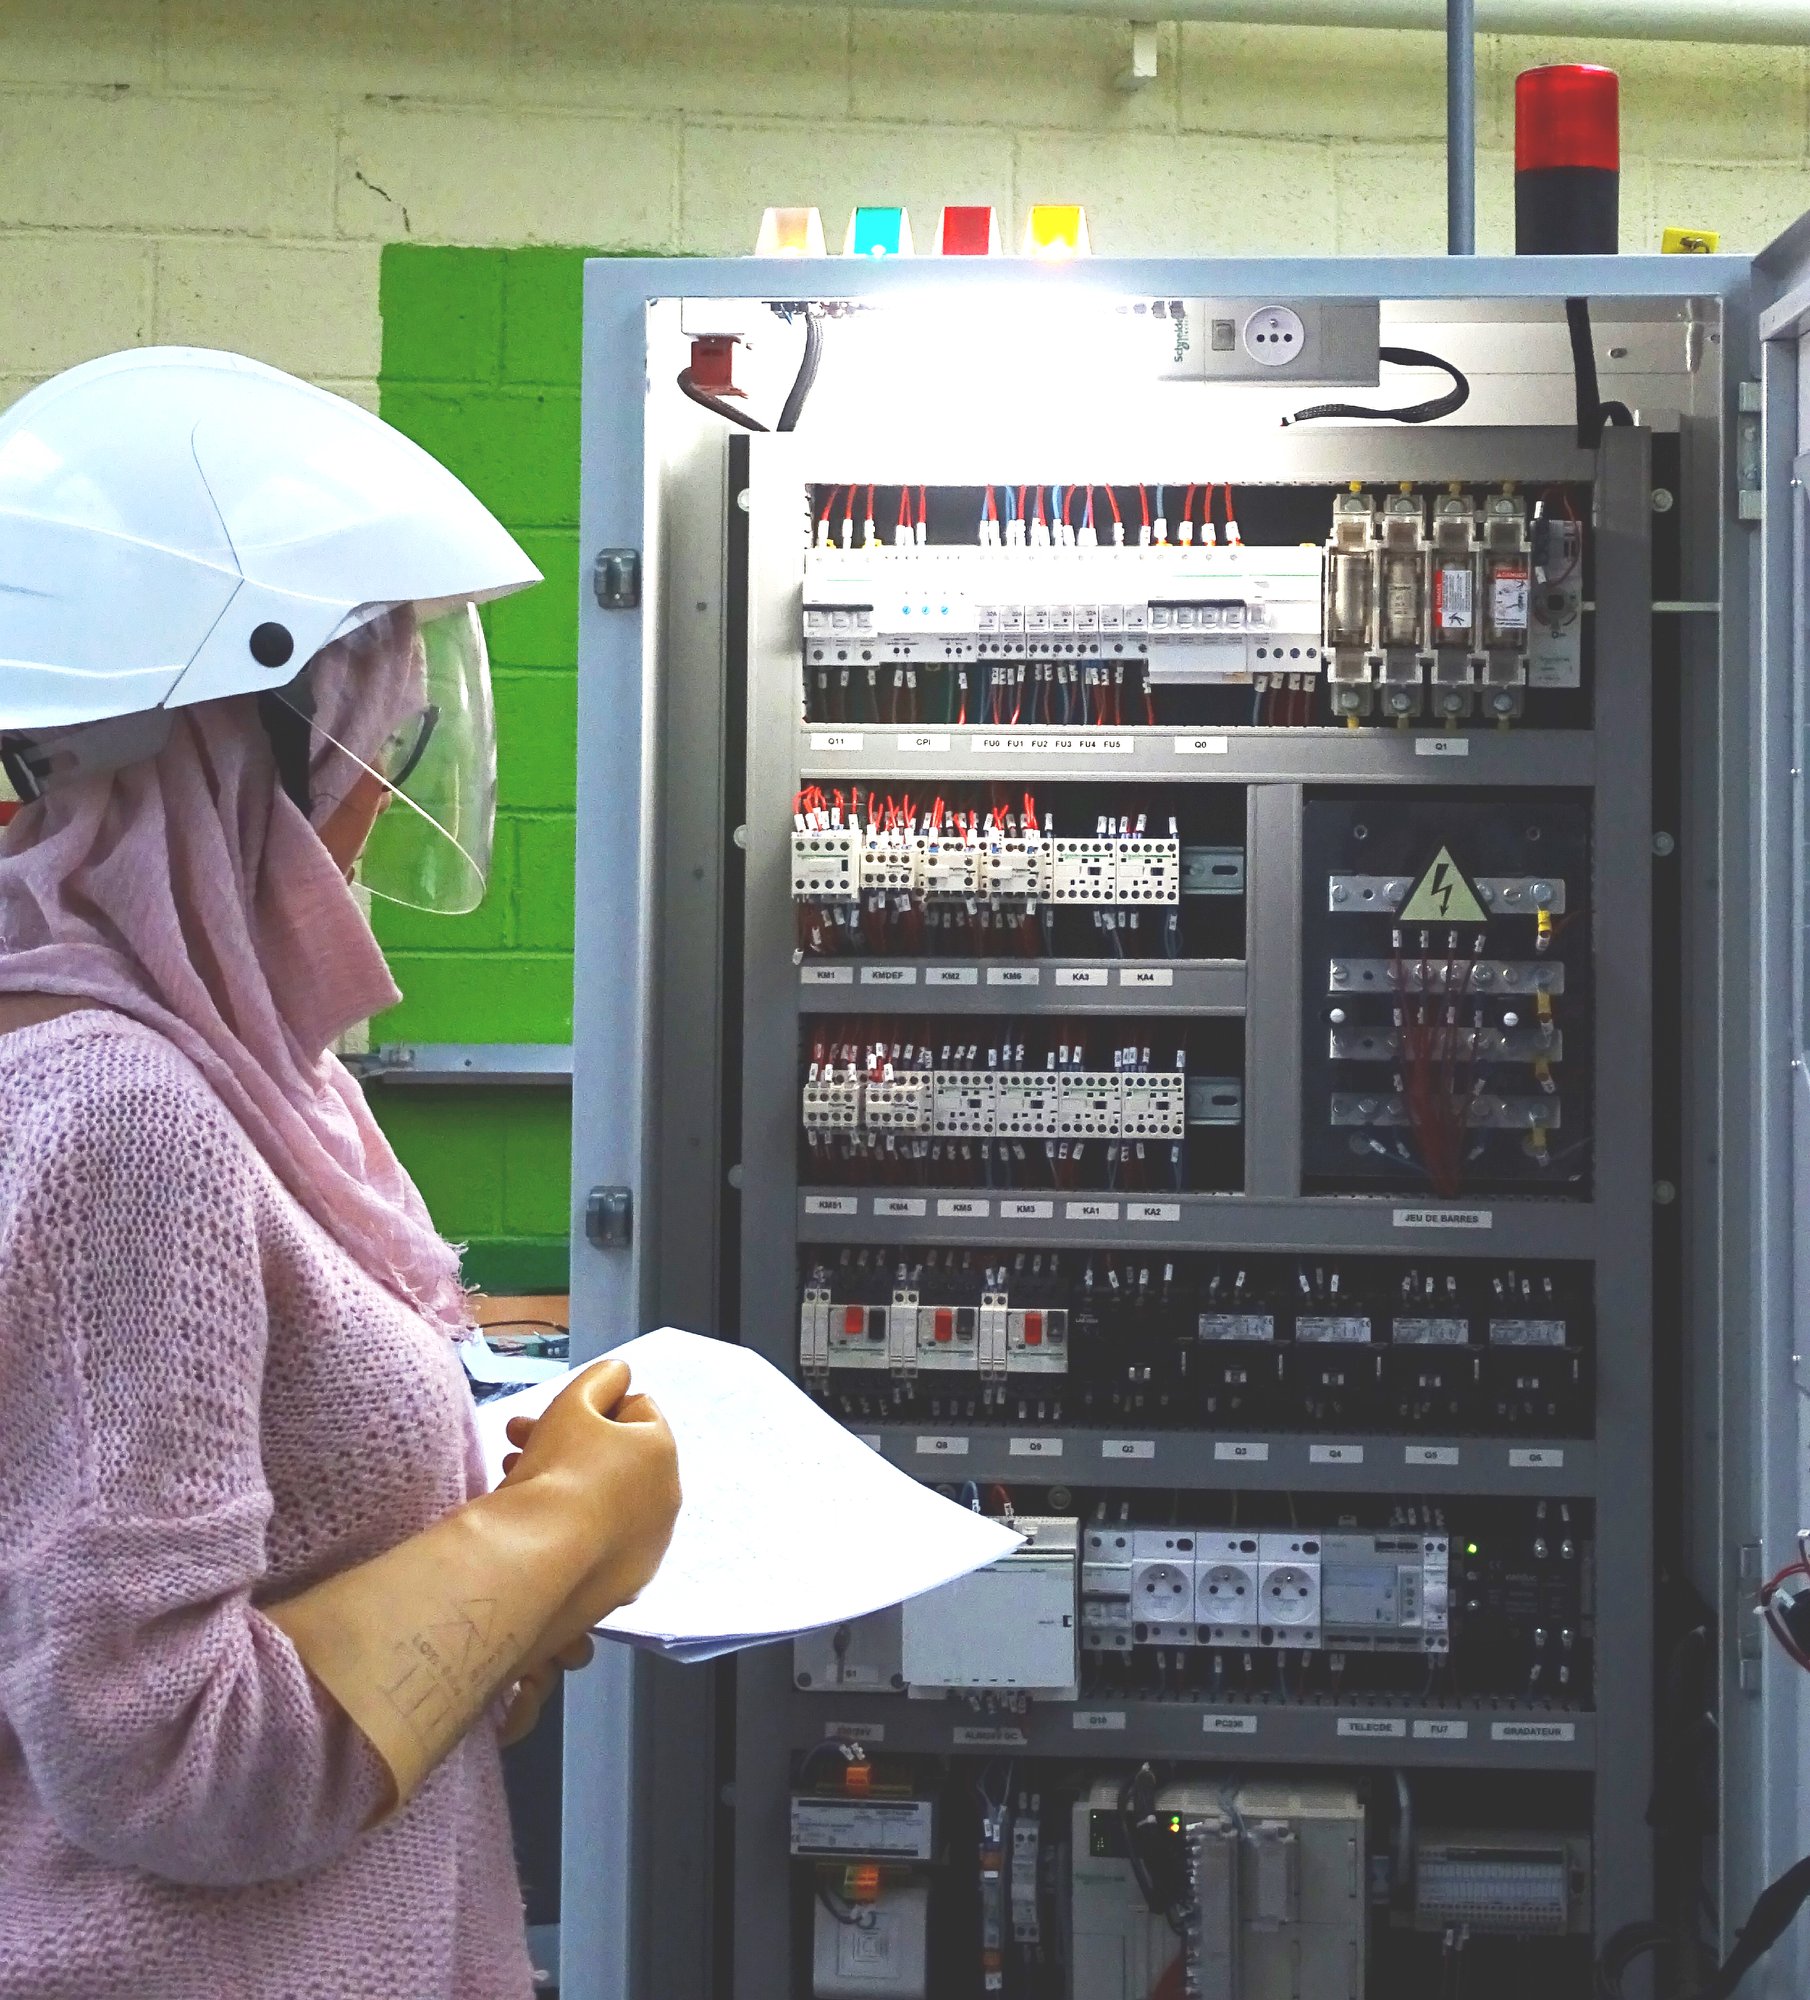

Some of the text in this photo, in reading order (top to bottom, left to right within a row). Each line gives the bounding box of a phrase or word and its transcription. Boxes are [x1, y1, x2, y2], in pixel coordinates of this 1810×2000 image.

[1173, 317, 1190, 363] Schneide
[828, 737, 845, 745] Q11
[916, 738, 931, 746] CPI
[983, 739, 1121, 749] FU0 FU1 FU2 FU3 FU4 FU5
[1194, 740, 1207, 749] Q0
[1435, 742, 1448, 750] Q1
[817, 971, 835, 980] KM1
[872, 971, 903, 980] KMDEF
[941, 972, 960, 980] KM2
[1002, 972, 1022, 980] KM6
[1072, 972, 1090, 981] KA3
[1137, 973, 1154, 982] KA4
[889, 1202, 909, 1211] KM4
[953, 1203, 973, 1212] KM5
[1016, 1205, 1036, 1213] KM3
[1082, 1207, 1100, 1215] KA1
[1144, 1207, 1162, 1216] KA2
[1404, 1214, 1480, 1225] JEU DE BARRES
[935, 1440, 948, 1449] Q8
[1029, 1442, 1042, 1451] Q9
[1121, 1445, 1135, 1454] Q2
[1234, 1447, 1247, 1456] Q3
[1329, 1449, 1342, 1458] Q4
[1349, 1722, 1393, 1732] TELECDE
[1430, 1725, 1449, 1734] FU7
[1503, 1727, 1562, 1737] GRADATEUR
